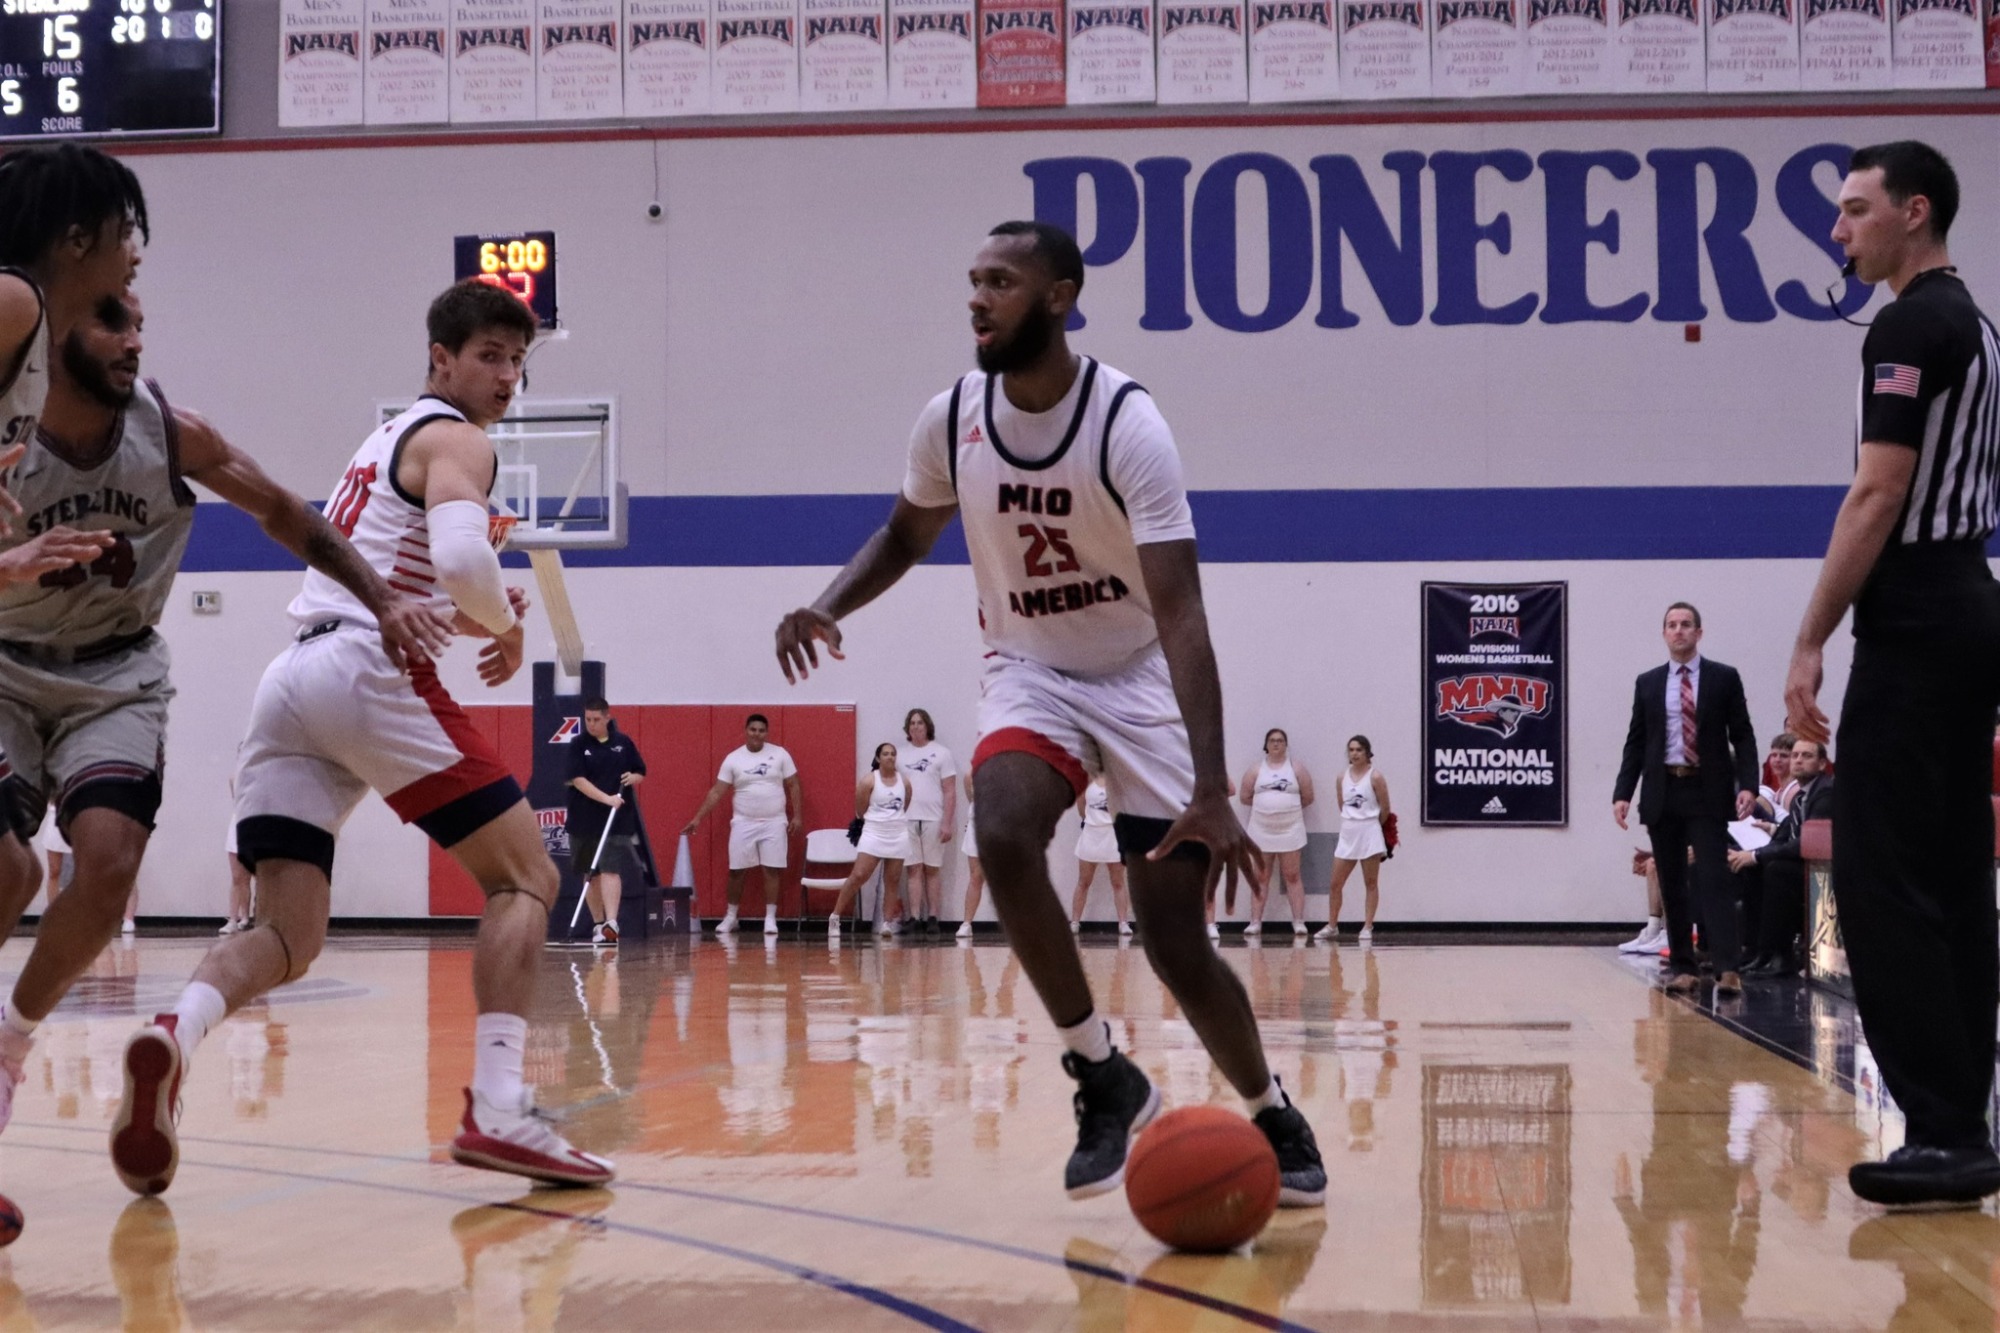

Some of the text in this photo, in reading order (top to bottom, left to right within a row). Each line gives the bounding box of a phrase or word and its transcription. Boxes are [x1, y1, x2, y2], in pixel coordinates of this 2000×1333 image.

[1075, 9, 1144, 33] NAIA
[1165, 8, 1237, 32] NAIA
[1256, 2, 1328, 28] NAIA
[1347, 2, 1419, 32] NAIA
[1439, 1, 1511, 30] NAIA
[1530, 0, 1603, 22] NAIA
[1622, 0, 1695, 21] NAIA
[1715, 0, 1787, 20] NAIA
[1807, 0, 1881, 19] NAIA
[111, 15, 145, 43] 20
[632, 22, 702, 47] NAIA
[720, 19, 790, 44] NAIA
[808, 17, 878, 41] NAIA
[897, 14, 967, 39] NAIA
[985, 12, 1056, 36] NAIA
[43, 14, 80, 59] 15
[288, 33, 355, 56] NAIA
[373, 31, 441, 54] NAIA
[459, 29, 527, 53] NAIA
[546, 24, 613, 49] NAIA
[42, 61, 83, 75] FOULS
[0, 77, 80, 114] 5 6
[41, 117, 83, 131] SCORE
[1023, 142, 1877, 333] PIONEERS
[481, 240, 546, 272] 6:00
[998, 482, 1072, 516] MIO
[1018, 523, 1081, 577] 25
[1009, 574, 1129, 618] AMERICA
[1470, 595, 1520, 613] 2016
[1470, 616, 1519, 637] NAIA
[1436, 654, 1553, 664] WOMENS BASKETBALL
[1469, 645, 1514, 653] DIVISION
[1438, 674, 1549, 715] MNU
[1435, 748, 1553, 767] NATIONAL
[1435, 769, 1553, 785] CHAMPIONS
